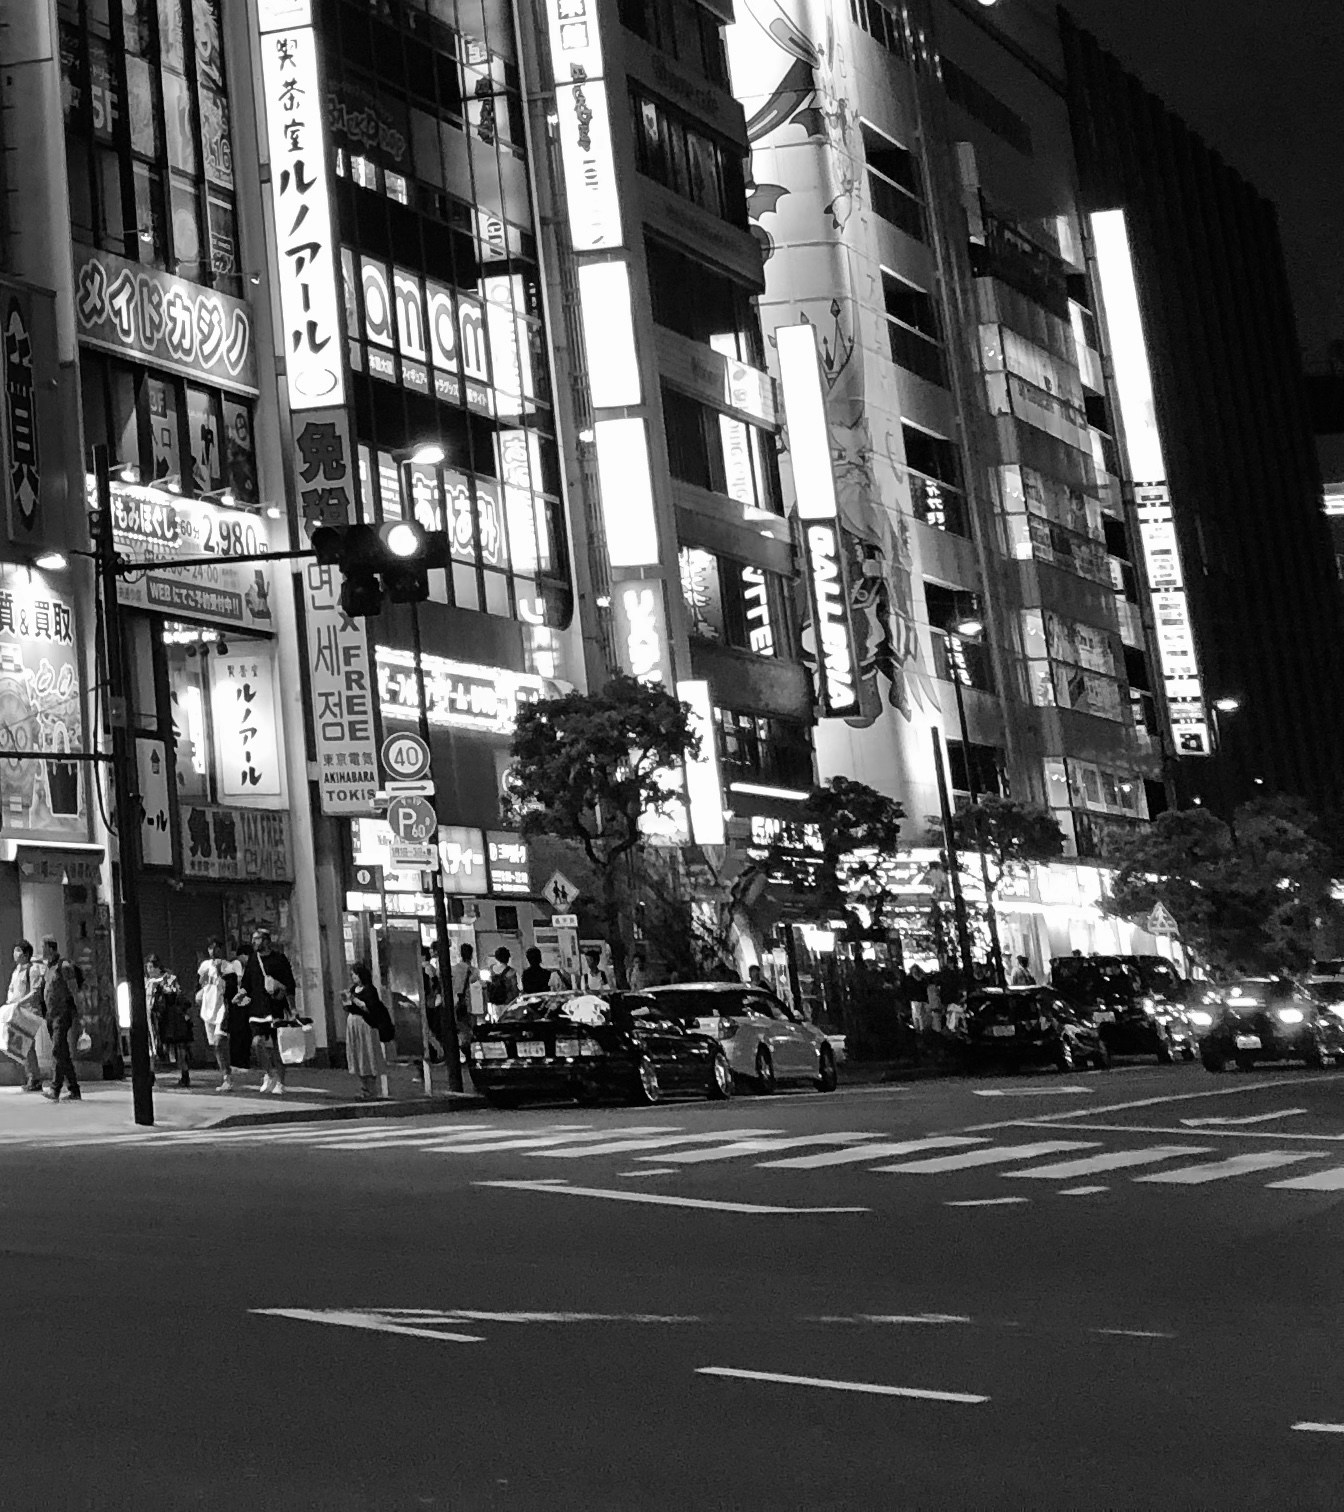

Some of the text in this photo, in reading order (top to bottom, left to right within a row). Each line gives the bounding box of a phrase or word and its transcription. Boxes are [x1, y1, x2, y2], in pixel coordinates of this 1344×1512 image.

[80, 258, 250, 377] メイドカジノ
[308, 562, 347, 742] 면세점
[341, 644, 371, 742] FREE
[235, 682, 264, 787] ルノアール
[322, 770, 377, 785] AKIHABARA
[393, 745, 420, 767] 40
[398, 807, 426, 839] P 60
